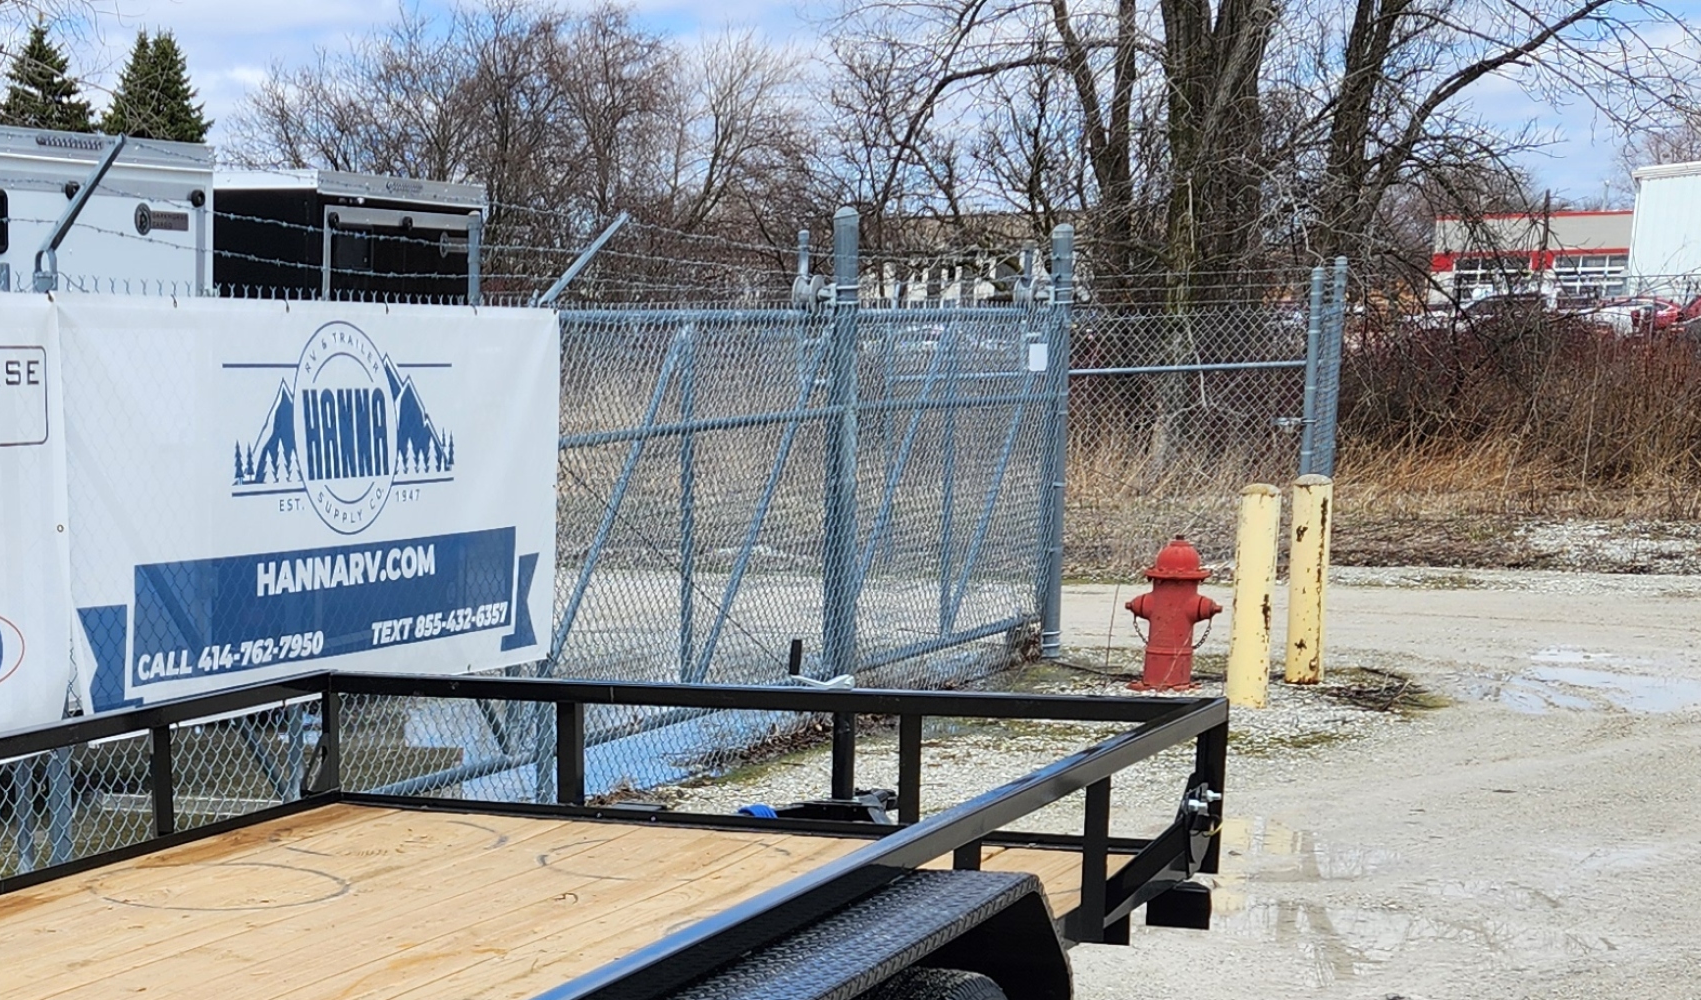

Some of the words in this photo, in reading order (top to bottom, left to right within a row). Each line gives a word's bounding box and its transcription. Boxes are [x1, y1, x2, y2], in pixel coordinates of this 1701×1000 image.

[304, 350, 318, 374] RV
[332, 331, 381, 374] TRAILER
[302, 386, 390, 481] HANNA
[279, 498, 305, 512] EST.
[395, 489, 421, 502] 1947
[317, 491, 363, 524] SUPPLY
[256, 544, 436, 597] HANNARV.COM
[137, 652, 193, 681] CALL
[198, 631, 325, 673] 414-762-7950
[371, 617, 415, 646] TEXT
[414, 601, 508, 639] 855-432-6357
